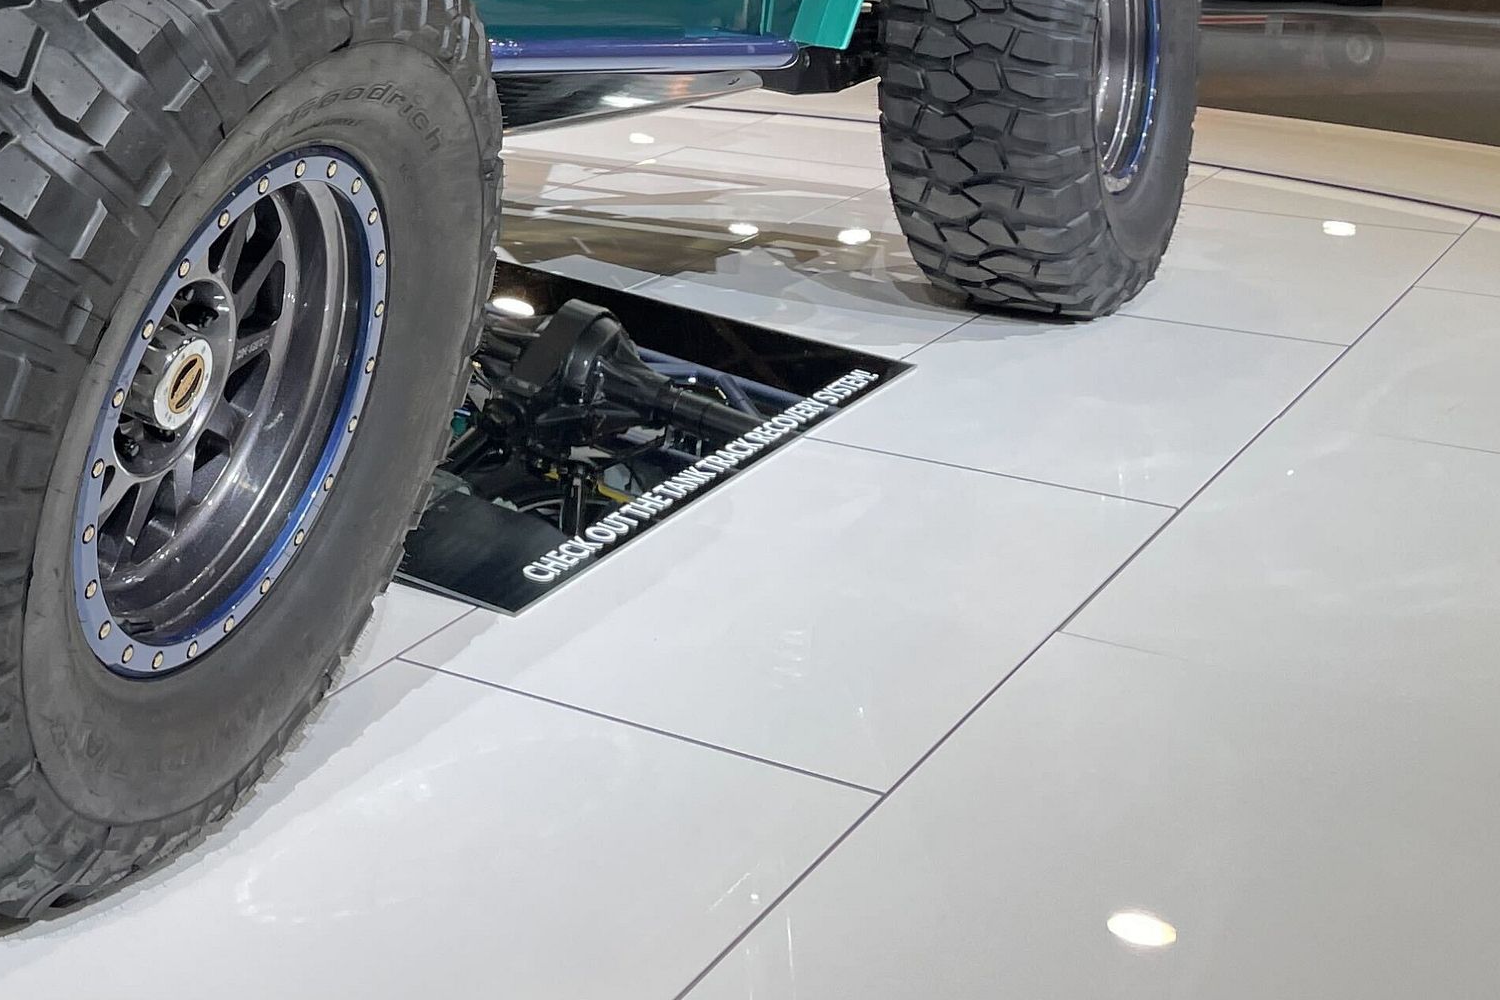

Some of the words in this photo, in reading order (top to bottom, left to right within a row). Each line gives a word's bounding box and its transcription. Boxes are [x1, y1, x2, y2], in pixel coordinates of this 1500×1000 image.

[523, 535, 604, 582] CHECK
[585, 511, 639, 543] OUT
[619, 483, 673, 519] THE
[652, 461, 717, 498] TANK
[696, 436, 763, 475] TRACK
[744, 397, 830, 448] RECOVERY
[812, 368, 879, 404] SYSTEM!
